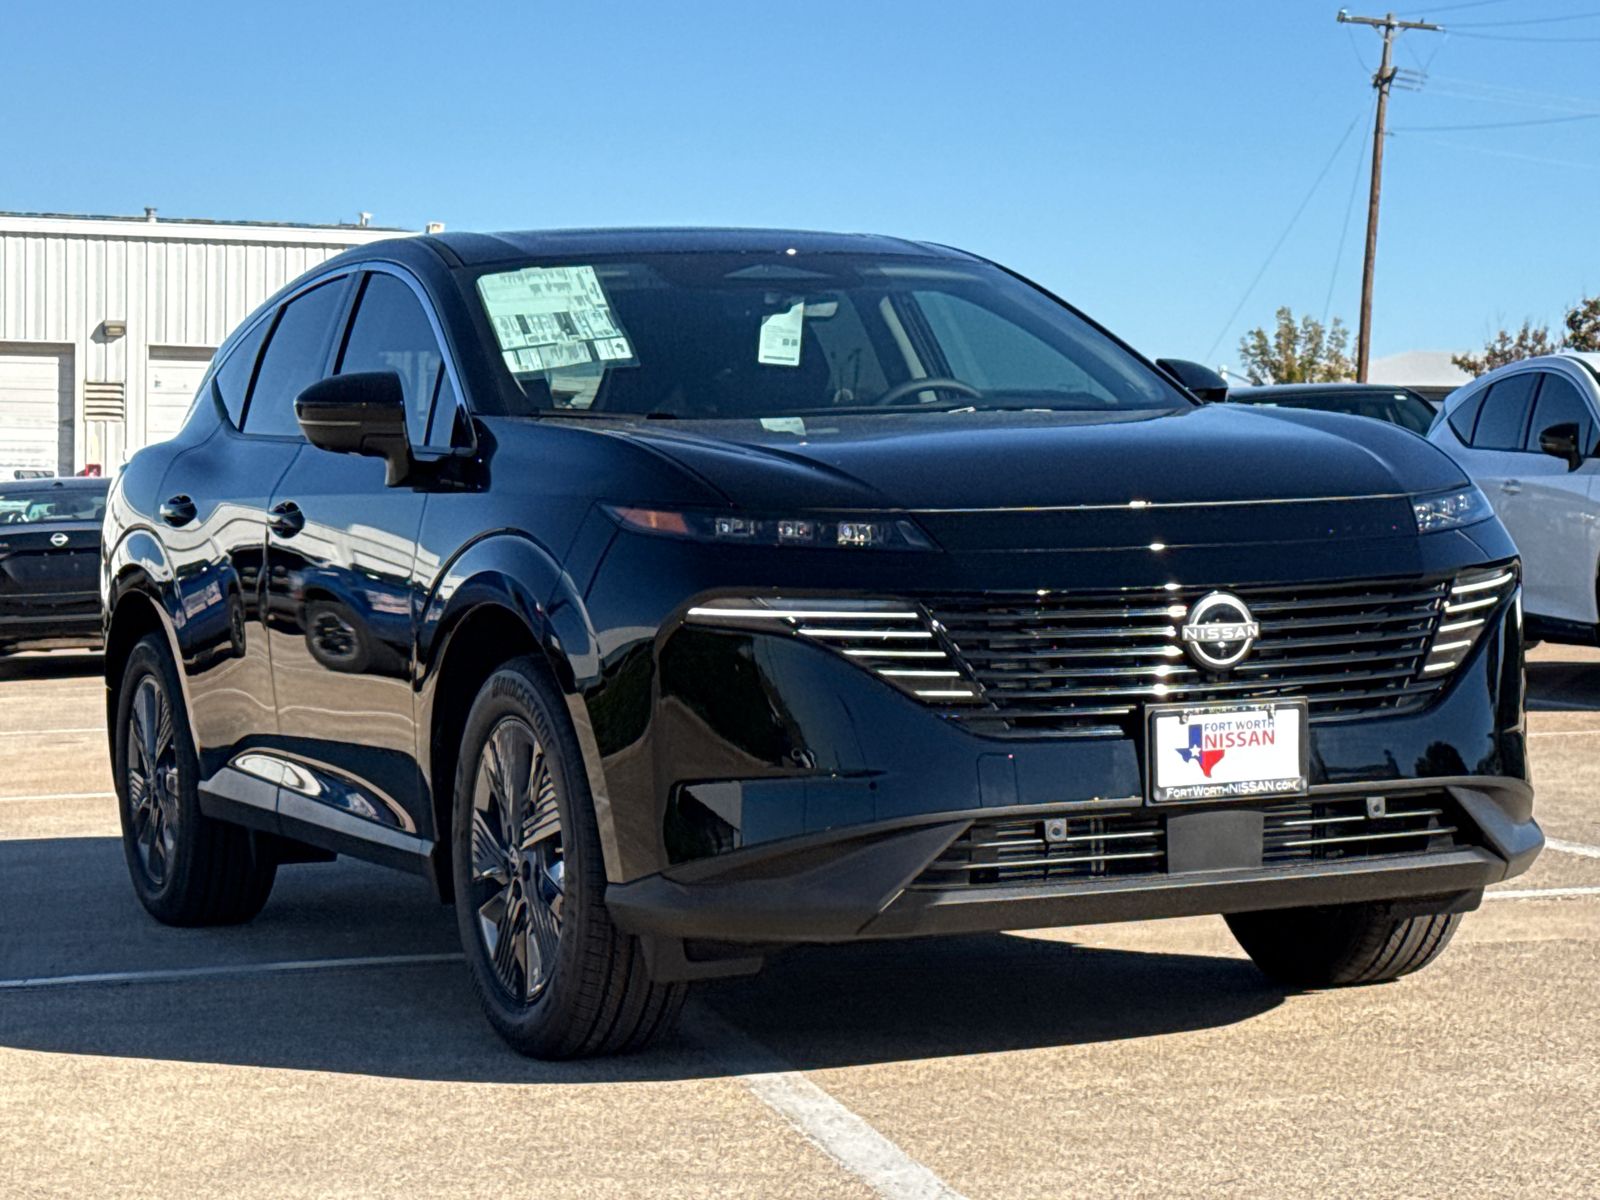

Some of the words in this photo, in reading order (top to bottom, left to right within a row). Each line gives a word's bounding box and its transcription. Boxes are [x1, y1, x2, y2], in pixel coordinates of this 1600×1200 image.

[1184, 625, 1258, 640] NISSAN
[492, 674, 556, 750] BRIDGESTONE
[1204, 721, 1233, 732] FORT
[1236, 718, 1275, 730] WORTH
[1204, 729, 1275, 749] NISSAN
